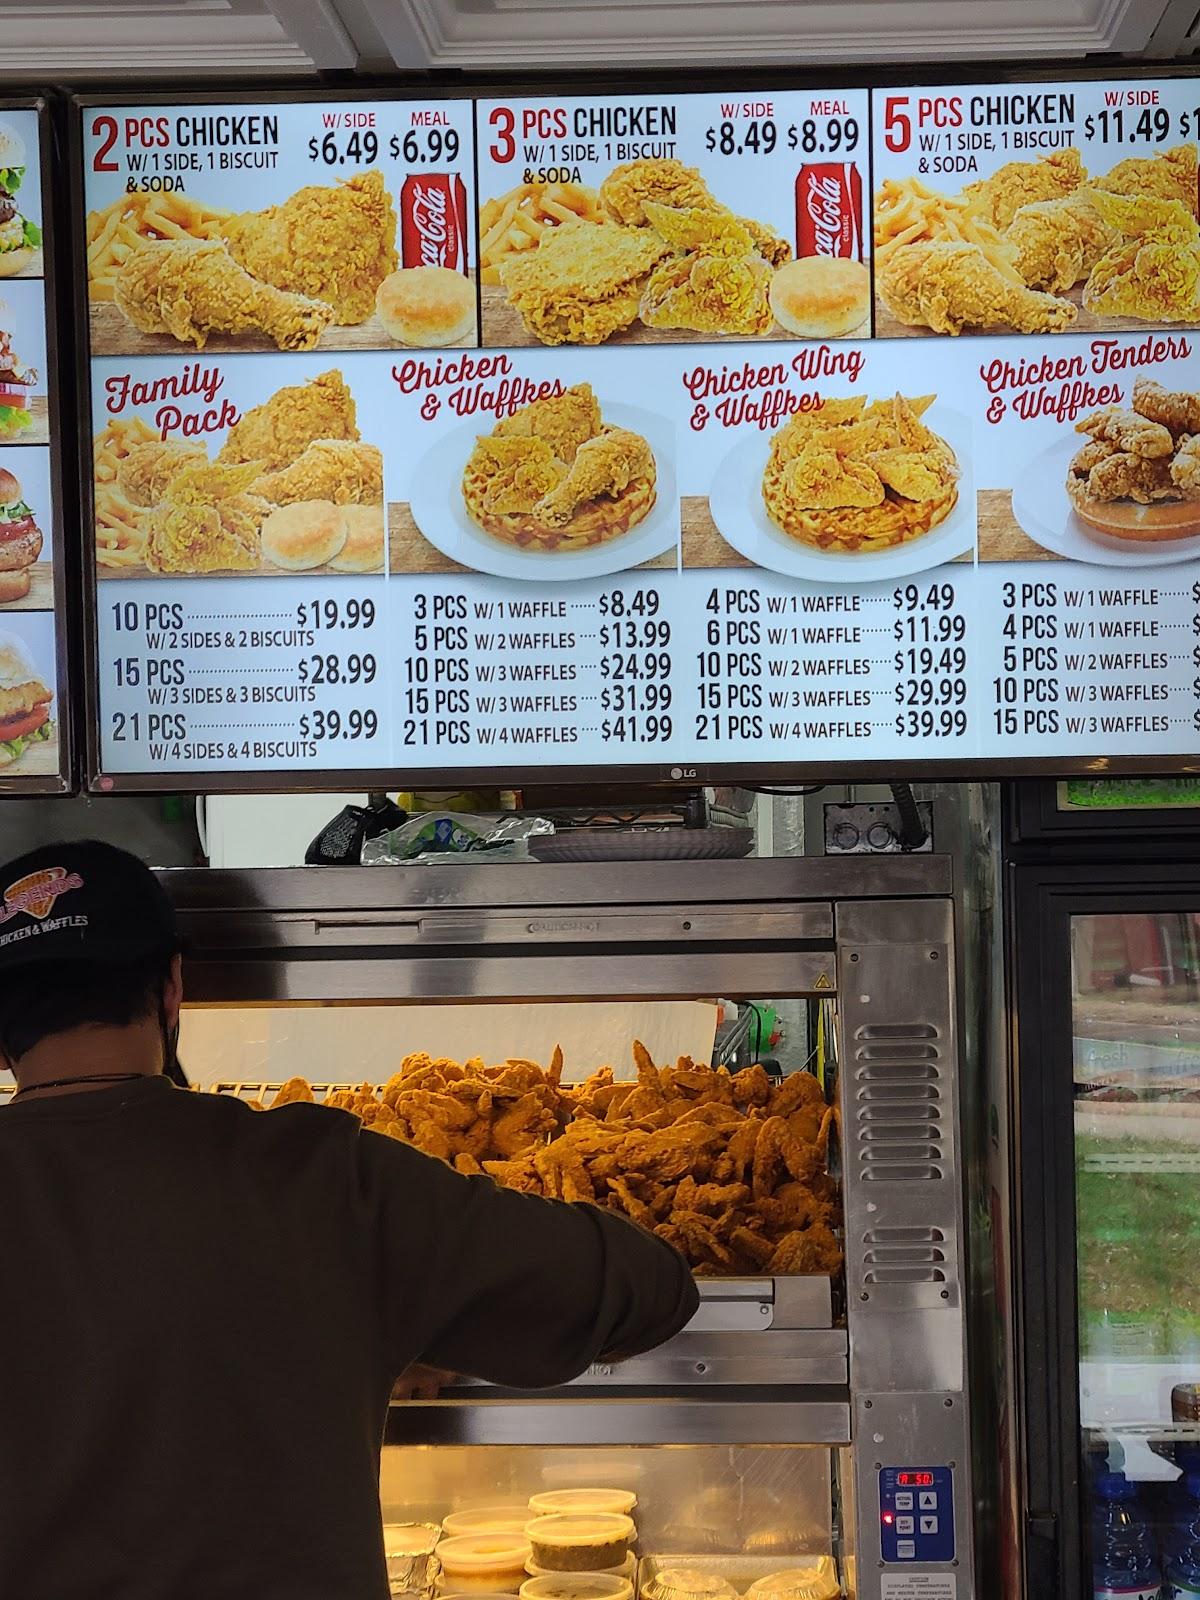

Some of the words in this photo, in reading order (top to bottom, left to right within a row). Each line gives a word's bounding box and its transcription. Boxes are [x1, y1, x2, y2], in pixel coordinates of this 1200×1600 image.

[743, 103, 773, 117] SIDE
[811, 101, 849, 115] MEAL
[919, 97, 962, 127] PCS
[971, 94, 1074, 126] CHICKEN
[1128, 90, 1159, 105] SIDE
[126, 118, 169, 147] PCS
[176, 116, 278, 146] CHICKEN
[345, 113, 375, 127] SIDE
[412, 112, 450, 126] MEAL
[523, 109, 566, 138] PCS
[574, 106, 676, 137] CHICKEN
[885, 97, 910, 152] 5
[1085, 108, 1169, 143] $11.49
[92, 116, 118, 172] 2
[309, 131, 378, 165] $6.49
[390, 129, 459, 163] $6.99
[490, 108, 515, 163] 3
[706, 121, 776, 155] $8.49
[788, 118, 858, 152] $8.99
[945, 134, 951, 150] 1
[958, 133, 996, 151] SIDE,
[1002, 132, 1007, 149] 1
[1014, 130, 1074, 148] BISCUIT
[152, 153, 158, 170] 1
[165, 153, 202, 172] SIDE,
[208, 152, 213, 169] 1
[220, 152, 278, 169] BISCUIT
[550, 144, 555, 162] 1
[562, 144, 599, 163] SIDE,
[605, 143, 610, 160] 1
[618, 142, 676, 160] BISCUIT
[919, 157, 929, 173] &
[934, 156, 978, 172] SODA
[126, 177, 138, 193] &
[142, 176, 184, 192] SODA
[523, 168, 534, 184] &
[538, 167, 581, 184] SODA
[392, 354, 512, 393] Chicken
[683, 362, 788, 400] Chicken
[792, 345, 865, 382] Wing
[980, 355, 1087, 393] Chicken
[1091, 336, 1192, 373] Tenders
[105, 363, 224, 413] Family
[156, 399, 241, 442] Pack
[421, 394, 441, 420] &
[690, 404, 710, 431] &
[987, 397, 1006, 424] &
[414, 594, 426, 619] 3
[434, 595, 466, 619] PCS
[498, 602, 503, 618] 1
[508, 602, 566, 618] WAFFLE
[600, 590, 659, 616] $8.49
[706, 588, 720, 614] 4
[726, 590, 760, 614] PCS
[791, 596, 796, 612] 1
[802, 596, 860, 612] WAFFLE
[894, 584, 954, 611] $9.49
[112, 602, 138, 631] 10
[146, 604, 183, 630] PCS
[298, 599, 375, 629] $19.99
[169, 632, 177, 648] 2
[182, 632, 221, 648] SIDES
[225, 632, 235, 647] &
[239, 631, 247, 647] 2
[251, 630, 314, 647] BISCUITS
[415, 625, 427, 650] 5
[434, 626, 467, 650] PCS
[498, 634, 506, 649] 2
[509, 633, 575, 649] WAFFLES
[600, 621, 670, 648] $13.99
[114, 658, 139, 686] 15
[147, 659, 184, 686] PCS
[298, 654, 376, 684] $28.99
[405, 657, 428, 682] 10
[435, 658, 468, 682] PCS
[498, 666, 506, 680] 3
[510, 665, 576, 680] WAFFLES
[601, 653, 671, 680] $24.99
[697, 652, 720, 677] 10
[728, 653, 761, 677] PCS
[792, 660, 799, 676] 2
[803, 660, 870, 675] WAFFLES
[895, 647, 966, 674] $19.49
[1004, 646, 1016, 671] 5
[1023, 647, 1057, 671] PCS
[1088, 654, 1096, 670] 2
[1100, 654, 1168, 670] WAFFLES
[698, 683, 720, 708] 15
[728, 684, 762, 708] PCS
[792, 692, 800, 706] 3
[803, 691, 870, 706] WAFFLES
[895, 678, 966, 706] $29.99
[994, 678, 1016, 703] 10
[1024, 678, 1058, 702] PCS
[1089, 686, 1096, 701] 3
[1100, 685, 1168, 701] WAFFLES
[113, 712, 138, 741] 21
[148, 714, 186, 740] PCS
[300, 710, 377, 739] $39.99
[404, 720, 427, 744] 21
[436, 721, 470, 744] PCS
[499, 728, 508, 743] 4
[511, 727, 577, 743] WAFFLES
[602, 716, 672, 742] $41.99
[696, 714, 720, 740] 21
[728, 716, 762, 739] PCS
[792, 722, 800, 738] 4
[804, 722, 871, 738] WAFFLES
[896, 710, 967, 737] $39.99
[994, 709, 1017, 734] 15
[1024, 710, 1058, 734] PCS
[1089, 717, 1097, 732] 3
[1101, 716, 1168, 732] WAFFLES
[172, 742, 181, 759] 4
[184, 743, 224, 759] SIDES
[228, 743, 238, 758] &
[241, 741, 250, 758] 4
[254, 742, 316, 758] BISCUITS
[684, 769, 697, 778] LG
[0, 926, 31, 947] HICKEN
[40, 915, 89, 932] WAFFLES
